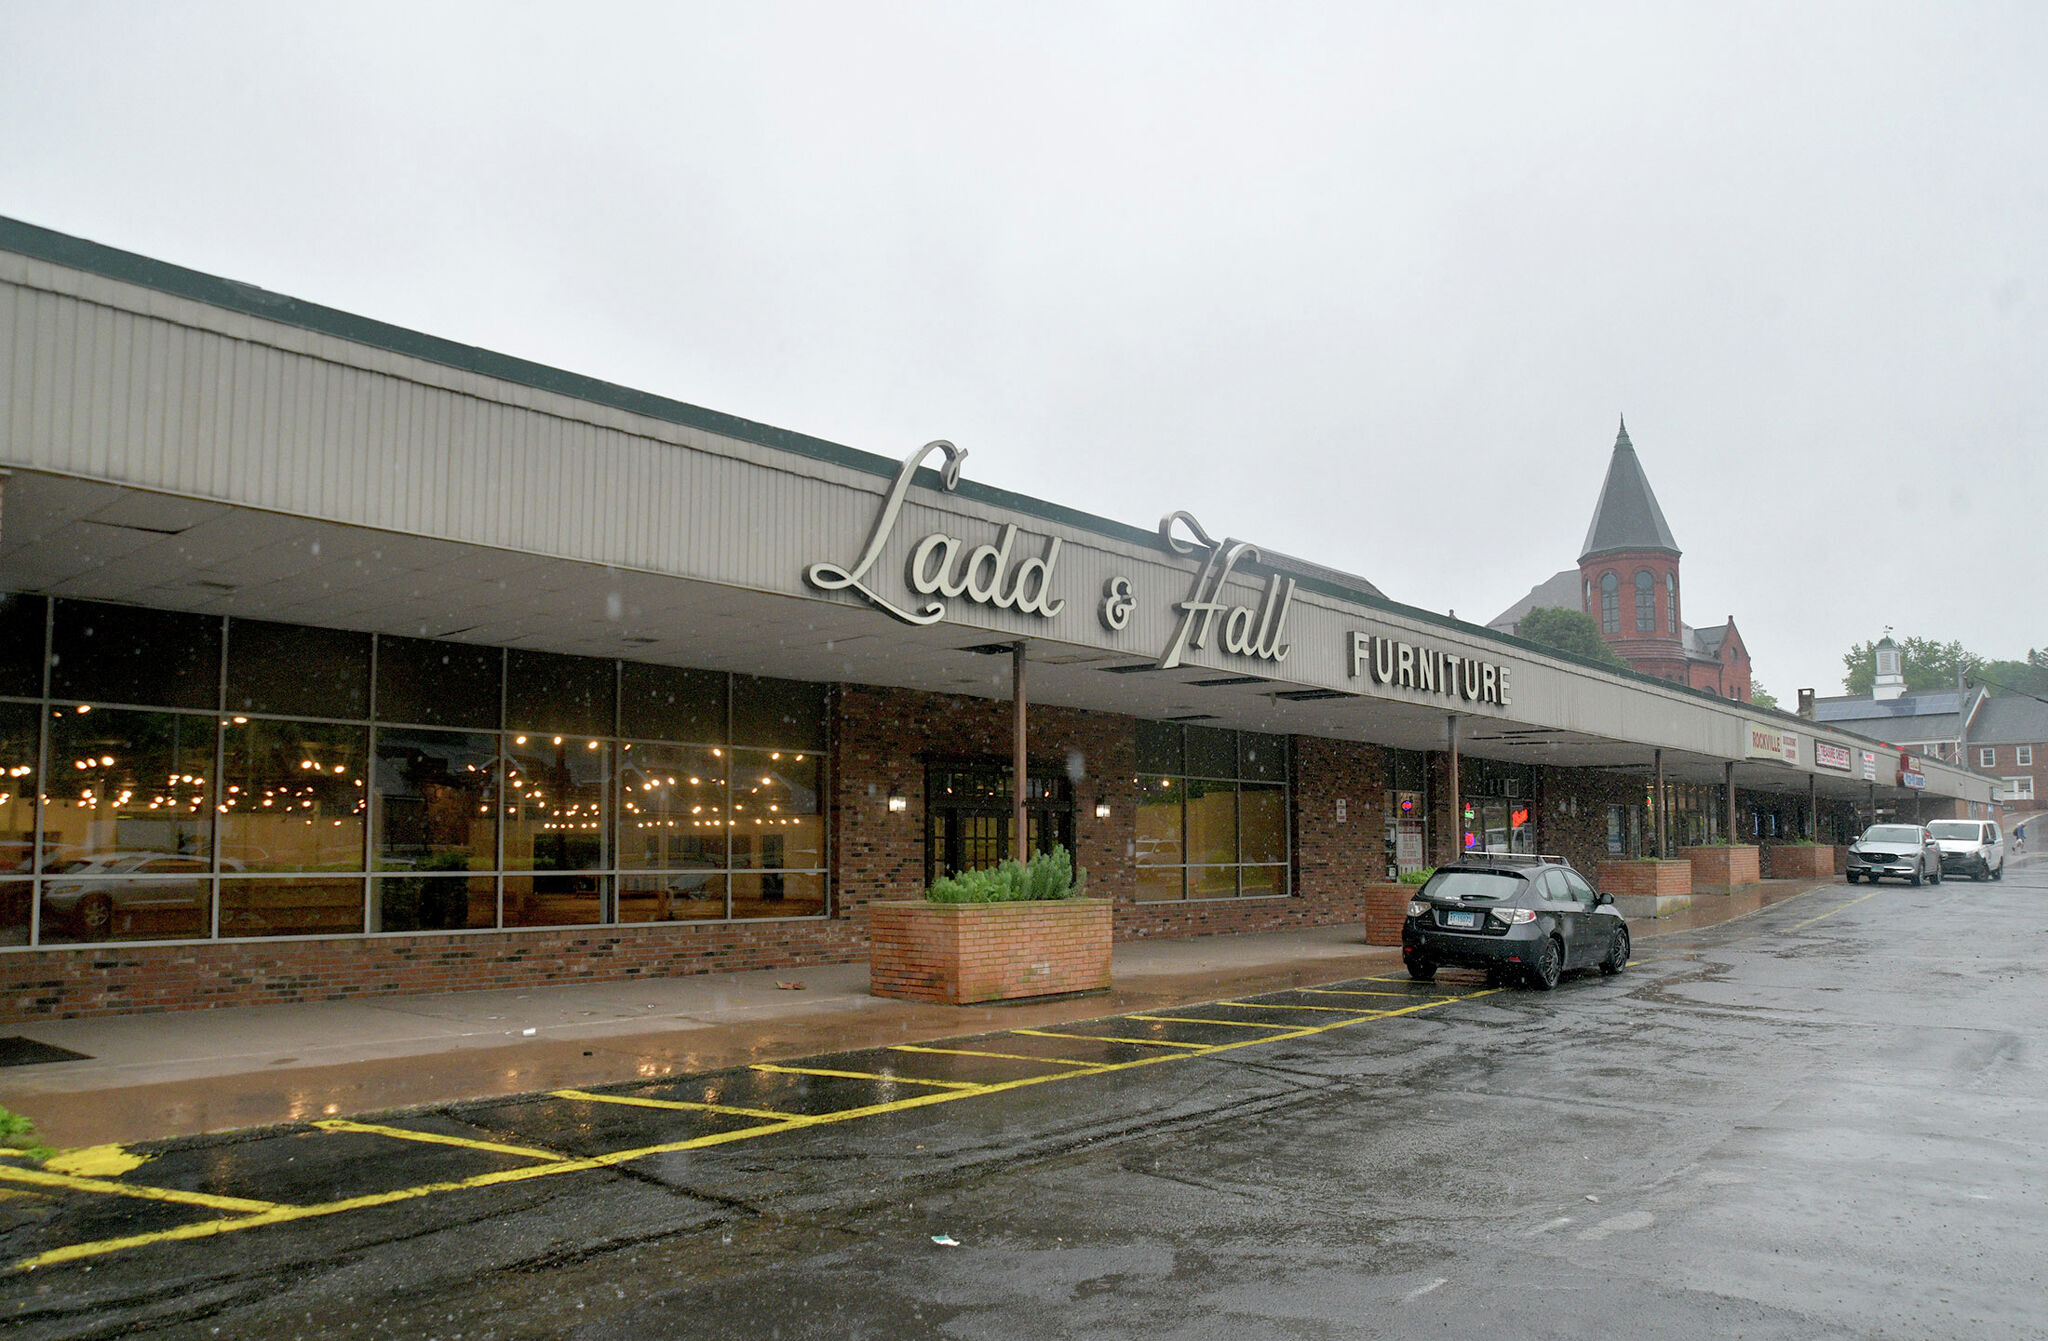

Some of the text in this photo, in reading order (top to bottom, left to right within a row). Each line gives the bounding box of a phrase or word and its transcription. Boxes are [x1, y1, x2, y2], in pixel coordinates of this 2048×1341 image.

[803, 440, 1296, 669] Ladd & Hall
[1347, 630, 1512, 705] FURNITURE
[1752, 731, 1781, 753] ROCKVILLE
